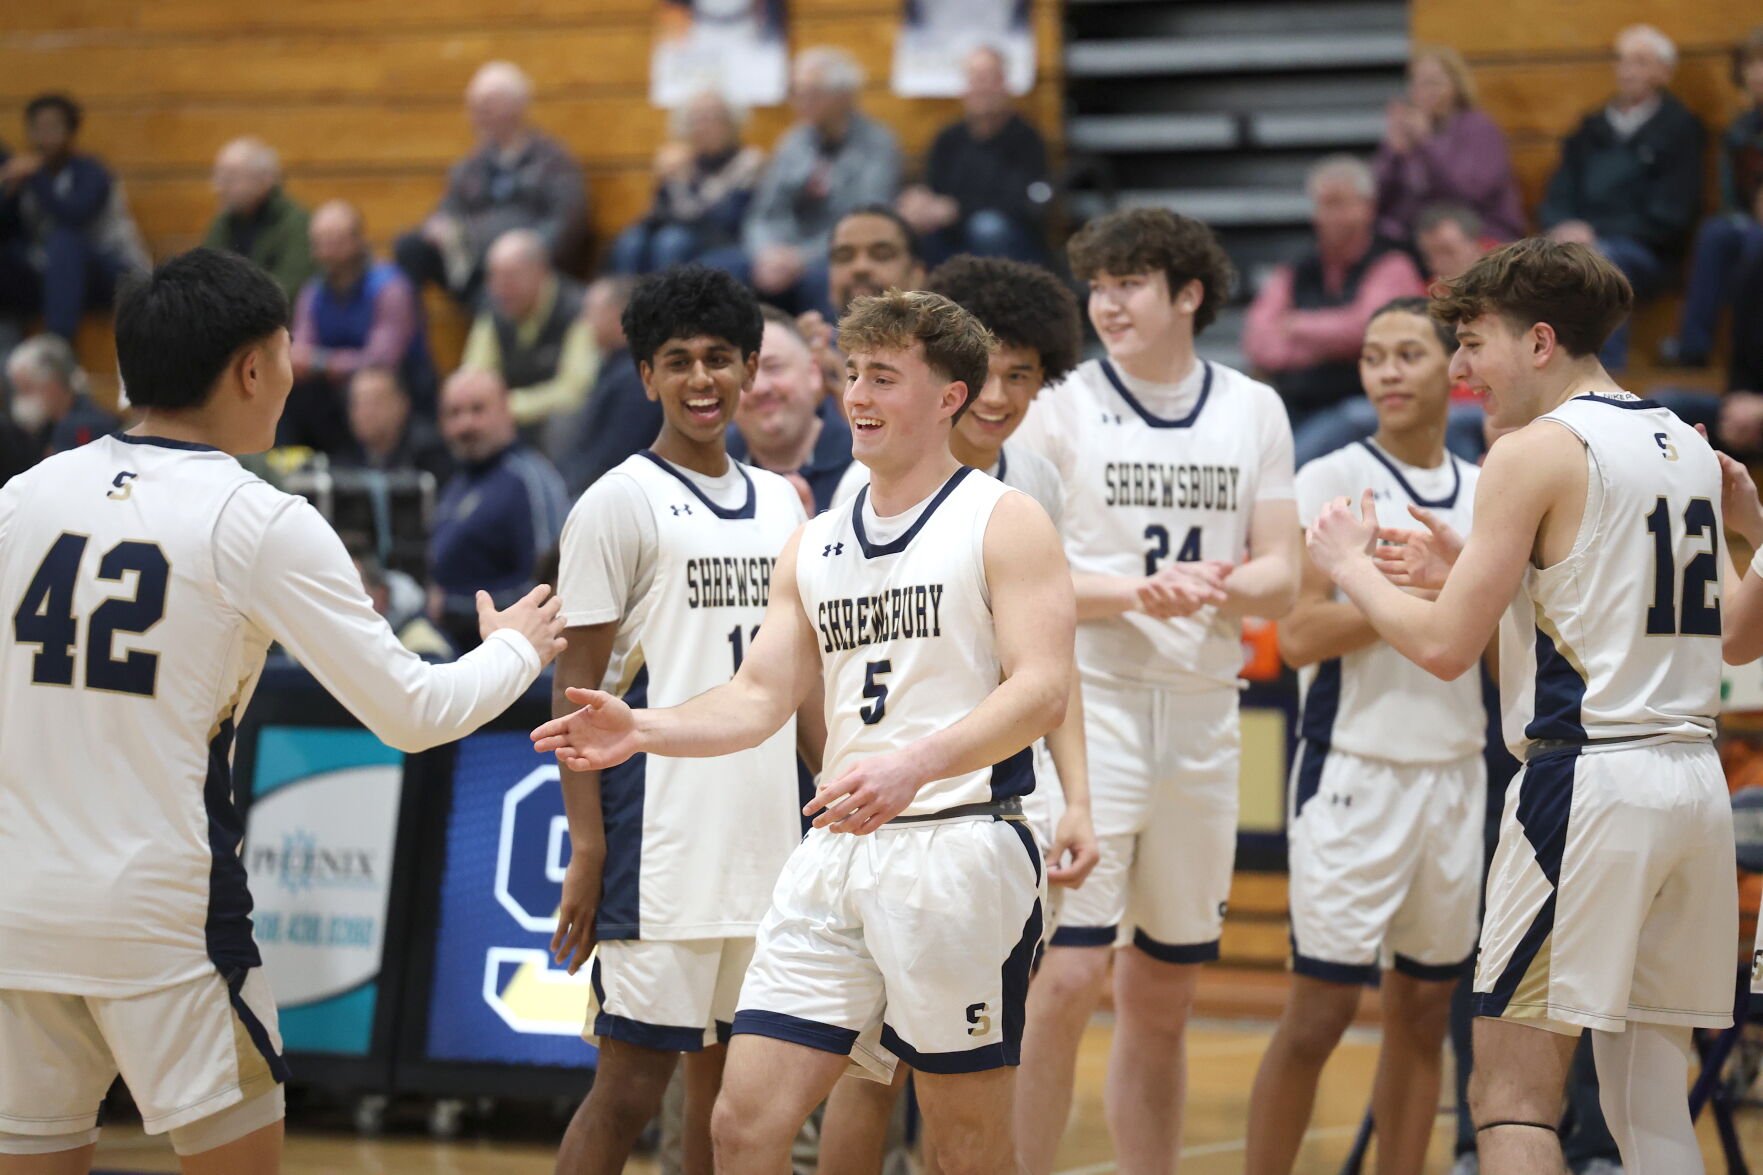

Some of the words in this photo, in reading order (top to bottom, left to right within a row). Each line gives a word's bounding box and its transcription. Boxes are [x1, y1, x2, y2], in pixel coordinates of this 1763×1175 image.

[1654, 432, 1679, 461] S
[106, 470, 138, 501] S
[1105, 462, 1239, 511] SHREWSBURY
[1144, 523, 1202, 577] 24
[1645, 494, 1722, 638] 12
[686, 557, 778, 609] SHREWSB
[12, 529, 173, 699] 42
[728, 623, 762, 681] 1
[859, 658, 892, 725] 5
[966, 1002, 991, 1037] S
